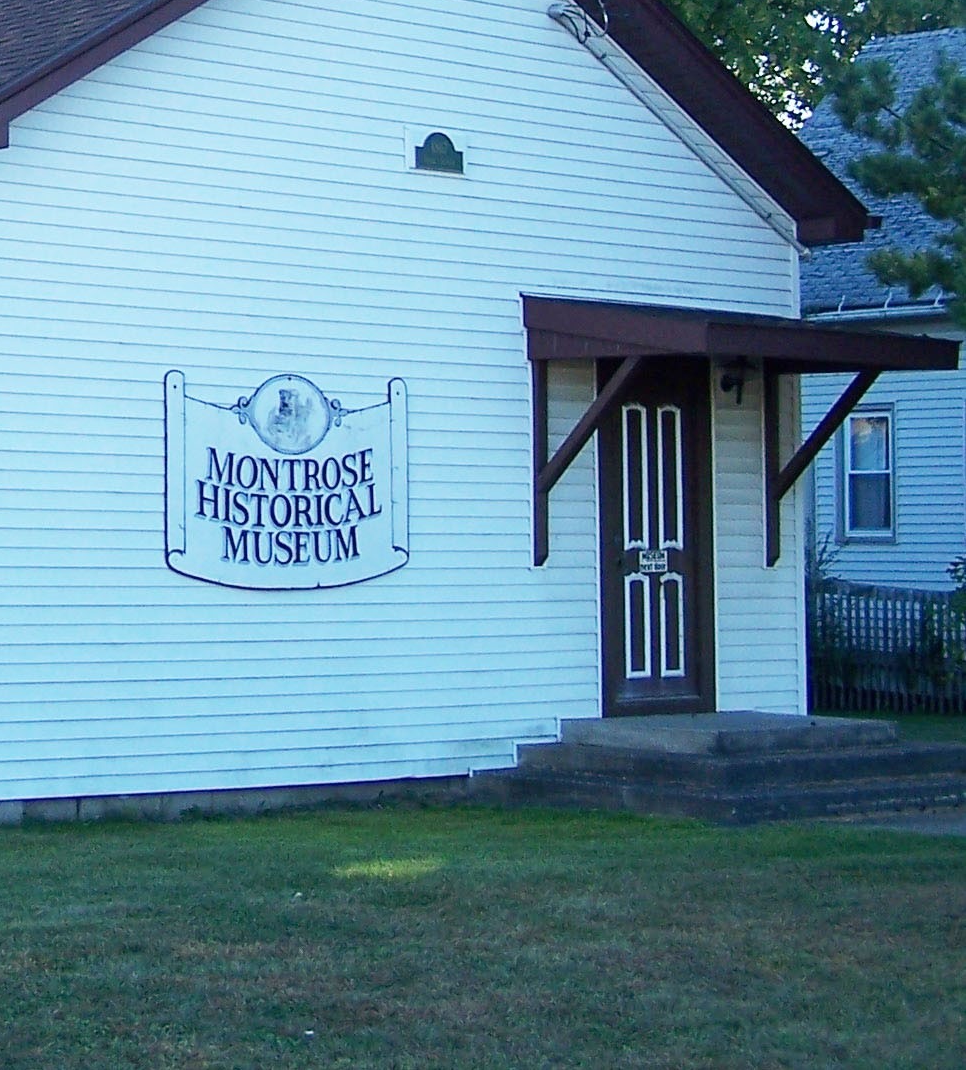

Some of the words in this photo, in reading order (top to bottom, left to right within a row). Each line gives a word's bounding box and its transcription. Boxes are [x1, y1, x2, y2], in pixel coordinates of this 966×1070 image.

[207, 447, 373, 492] MONTROSE
[195, 479, 382, 527] HISTORICAL
[221, 525, 360, 565] MUSEUM
